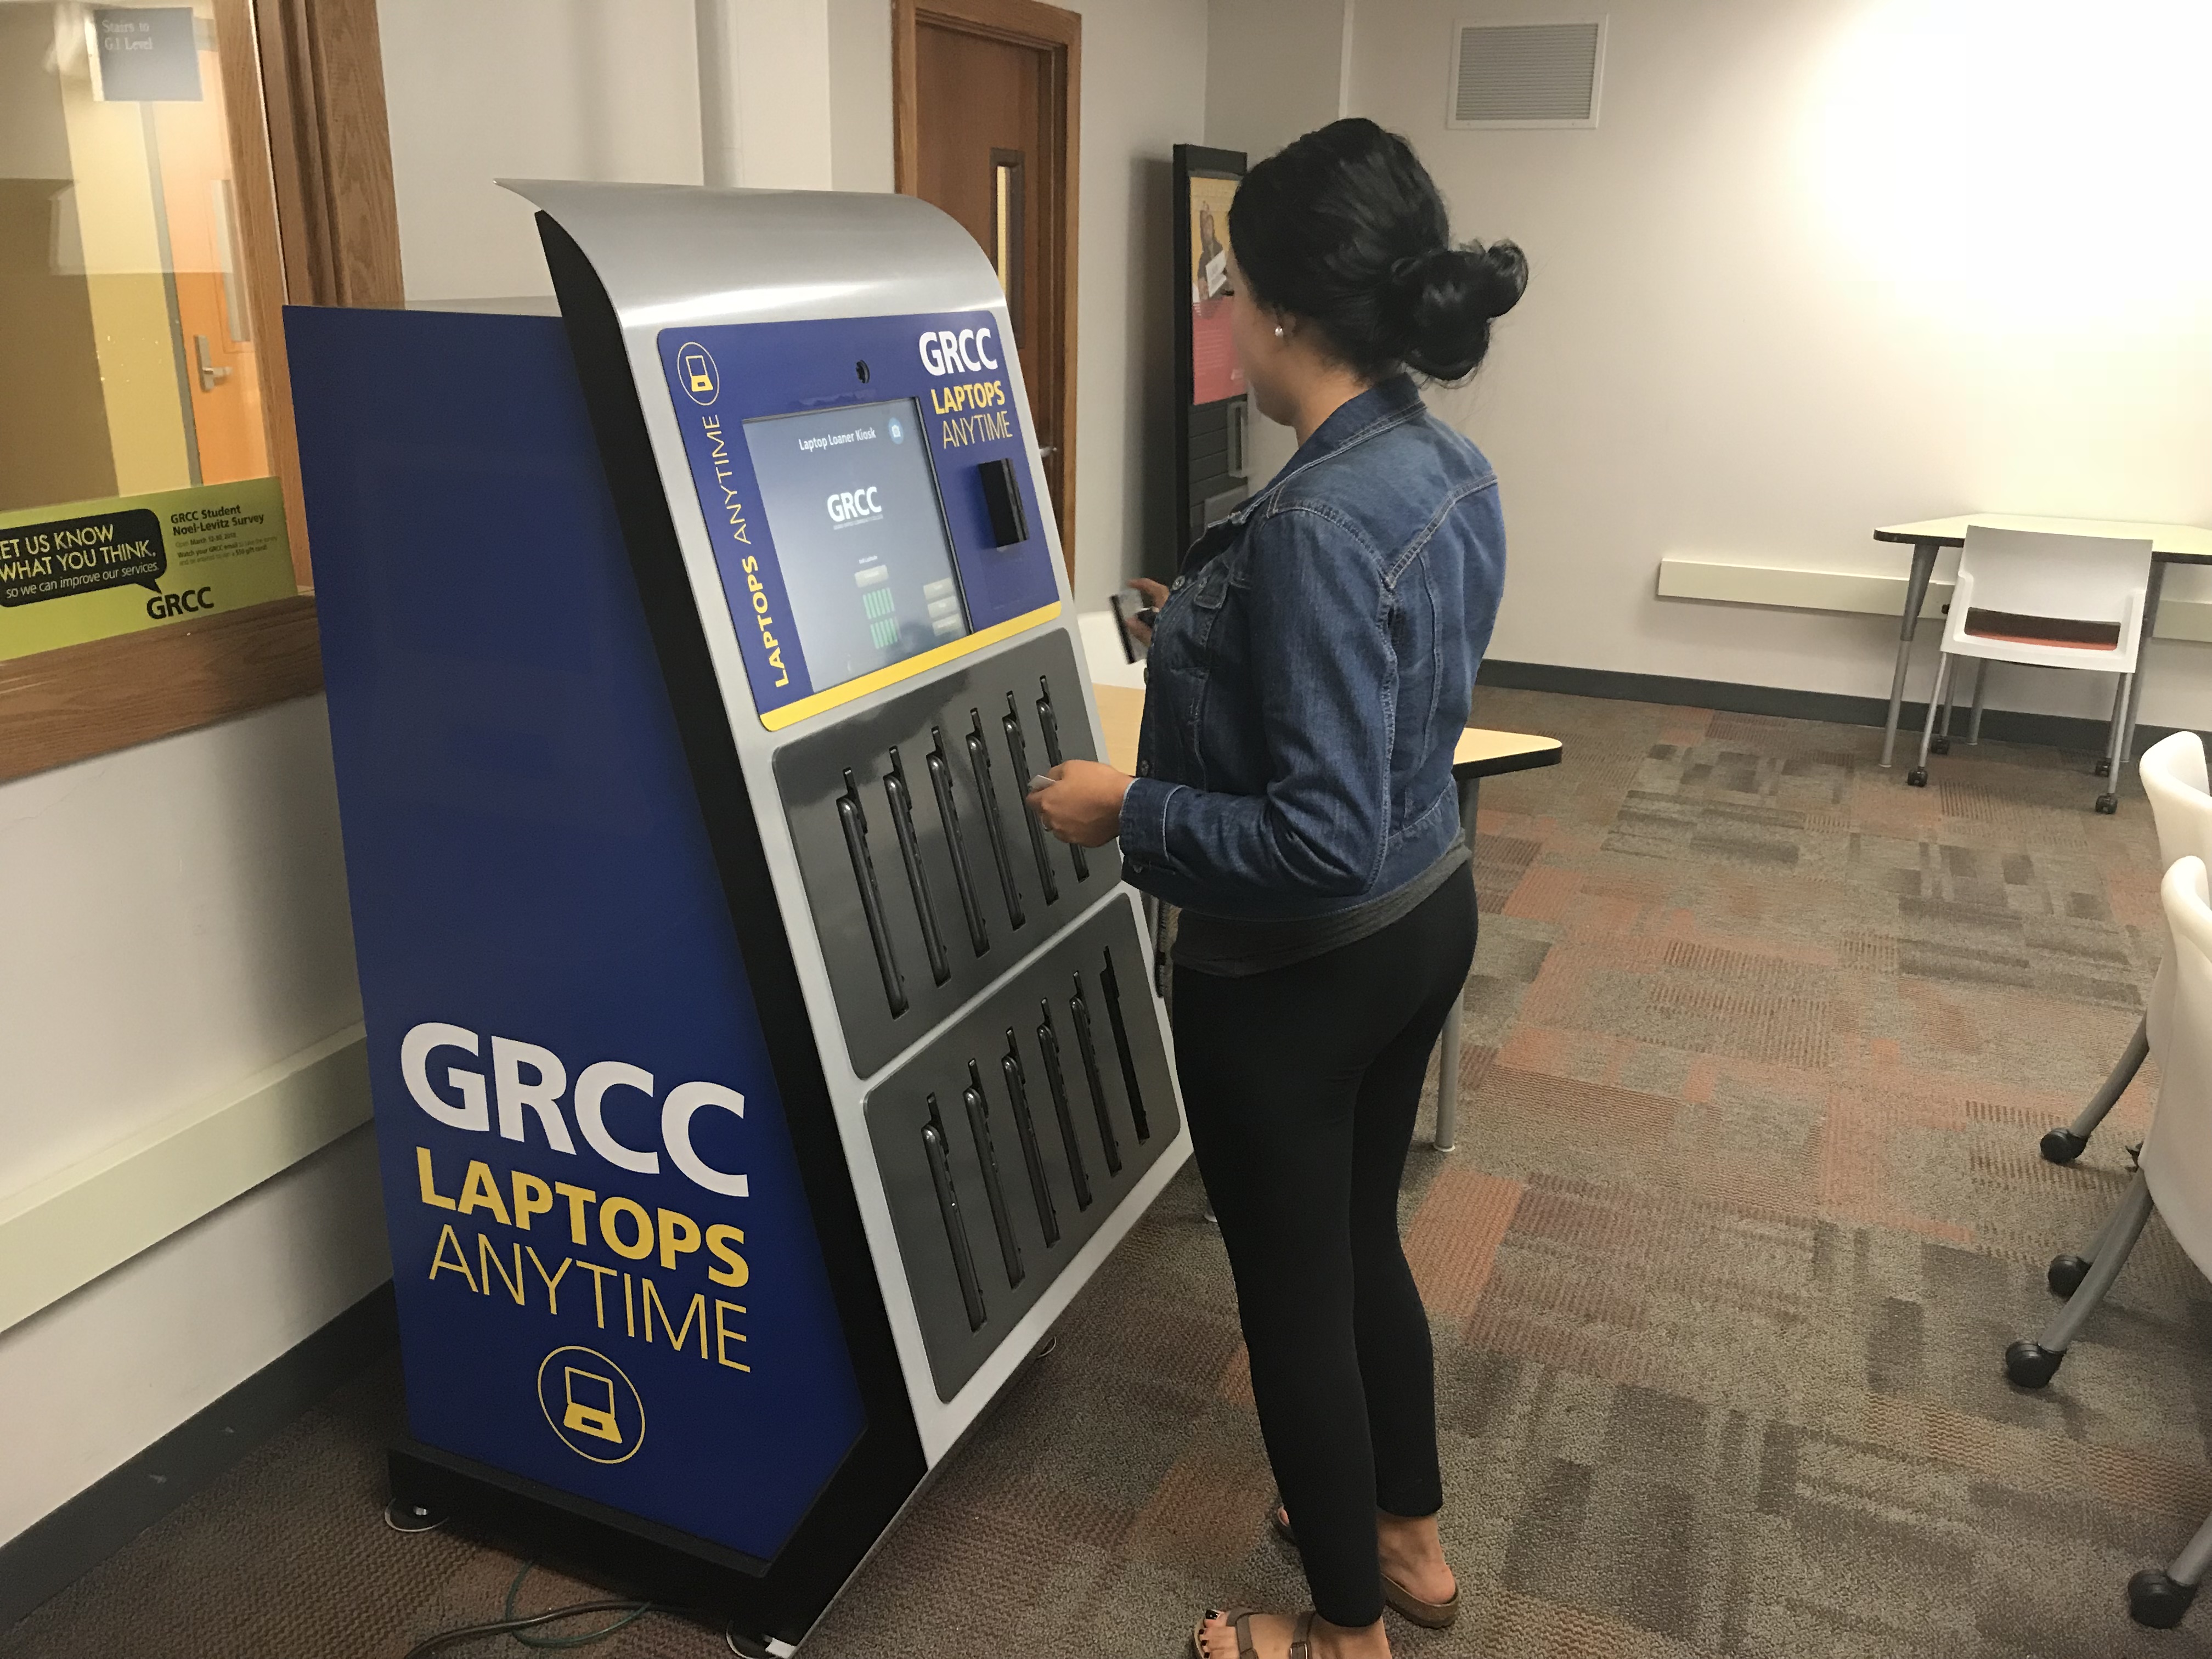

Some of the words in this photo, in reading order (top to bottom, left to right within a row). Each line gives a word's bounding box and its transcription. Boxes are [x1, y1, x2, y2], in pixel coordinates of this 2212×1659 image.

[919, 328, 998, 376] GRCC
[931, 380, 1006, 415] LAPTOPS
[799, 438, 827, 453] Laptop
[828, 432, 854, 446] Loaner
[855, 426, 877, 441] Kiosk
[943, 410, 1013, 449] ANYTIME
[702, 414, 752, 545] ANYTIME
[170, 510, 199, 524] GRCC
[201, 504, 241, 520] Student
[827, 486, 882, 522] GRCC
[25, 534, 50, 555] US
[53, 524, 114, 550] KNOW
[173, 519, 230, 536] Noel-Levitz
[231, 514, 264, 525] Survey
[0, 556, 52, 583] WHAT
[56, 549, 97, 572] YOU
[100, 539, 156, 565] THINK.
[6, 587, 19, 599] so
[20, 584, 37, 596] we
[39, 579, 58, 592] can
[60, 573, 100, 590] improve
[102, 568, 119, 581] our
[121, 561, 160, 578] services.
[146, 586, 215, 619] GRCC
[742, 555, 789, 687] LAPTOPS
[401, 1022, 749, 1197] GRCC
[416, 1146, 749, 1288] LAPTOPS
[429, 1223, 751, 1373] ANYTIME
